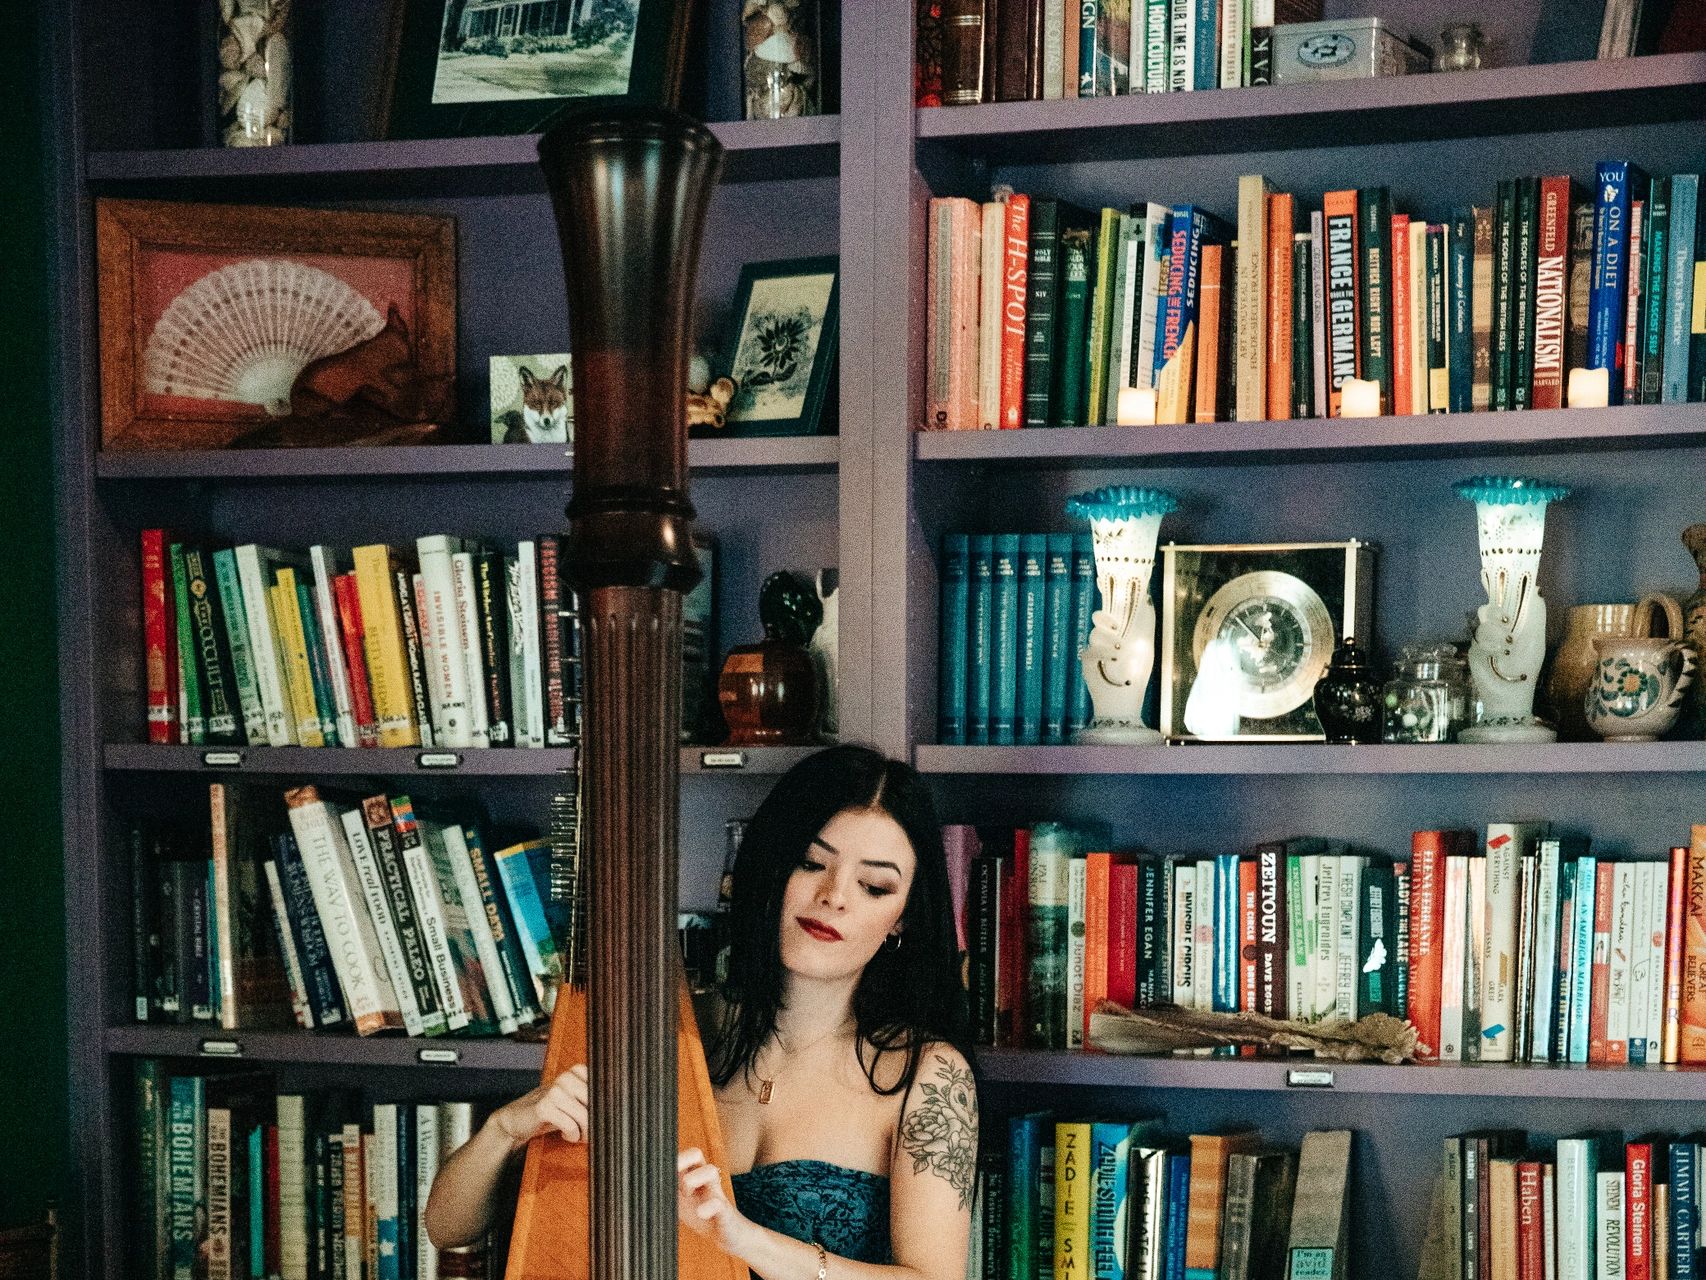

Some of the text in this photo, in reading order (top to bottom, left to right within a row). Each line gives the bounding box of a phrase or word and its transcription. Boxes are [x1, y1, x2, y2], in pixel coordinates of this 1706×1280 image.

[1147, 5, 1168, 95] HORTICULTURE
[1172, 23, 1187, 66] TIME IS
[1598, 171, 1624, 182] YOU
[1005, 202, 1029, 341] The H-SPOT
[1455, 254, 1466, 288] Anatomy
[1533, 191, 1564, 370] GREENFELD NATIONALISM
[1605, 206, 1622, 289] ON A DIET
[1674, 248, 1688, 288] Theory
[1163, 229, 1189, 360] SEDUCING FRENCH
[1328, 214, 1354, 390] FRANCE GERMANS
[1456, 289, 1466, 299] of
[1498, 221, 1510, 351] THE PEOPLES OF THE BRITISH ISLES
[1516, 220, 1528, 351] THE PEOPLES OF THE BRITISH ISLES
[1648, 230, 1663, 355] MAKING THE FASCIST SELF
[1370, 334, 1382, 358] LEFT
[454, 560, 472, 650] Gloria Steinem
[432, 590, 454, 699] INVISIBLE WOMEN
[352, 832, 368, 863] LOVE
[369, 893, 386, 925] FOOD
[470, 847, 506, 942] SMALL DATA
[1398, 876, 1410, 905] LADY
[1501, 847, 1511, 879] AGAINST
[1690, 856, 1704, 917] MAKKAI
[312, 832, 366, 991] THE WAY TO COOK
[377, 828, 426, 981] PRACTICAL PALEO
[1143, 865, 1155, 959] JENNIFER EGAN
[1247, 891, 1255, 940] THE CIRCLE
[1261, 852, 1277, 944] ZEITOUN
[1340, 873, 1354, 940] FRESH COMPLAINT
[1419, 850, 1434, 956] ELENA FERRANTE
[426, 917, 457, 1009] Small Business
[1177, 945, 1192, 988] CIRCUS
[1264, 952, 1273, 981] DAVE
[1319, 905, 1332, 961] Eugenides
[1397, 934, 1409, 963] LAKE
[1575, 902, 1589, 1021] AN AMERICAN MARRIAGE
[1247, 965, 1255, 989] DAVE
[1338, 952, 1352, 989] JEFFREY
[1686, 954, 1697, 1003] BELIEVERS
[1697, 962, 1706, 994] GREAT
[172, 1122, 194, 1241] BOHEMIANS
[418, 1114, 433, 1186] A Warning
[1063, 1133, 1077, 1216] ZADIE
[1466, 1150, 1475, 1180] MARCH
[210, 1142, 228, 1235] BOHEMIANS
[1098, 1144, 1118, 1238] ZADIE SMITH
[1141, 1174, 1151, 1205] THE
[1520, 1170, 1538, 1225] Haben
[1566, 1157, 1576, 1222] BECOMING
[1605, 1179, 1621, 1211] STEINEM
[1632, 1159, 1646, 1256] Gloria Steinem
[1675, 1148, 1691, 1275] JIMMY CARTER
[1097, 1243, 1115, 1275] FEEL
[1136, 1213, 1149, 1257] HATE
[1605, 1219, 1621, 1276] REVOLUTION
[1136, 1262, 1147, 1276] U
